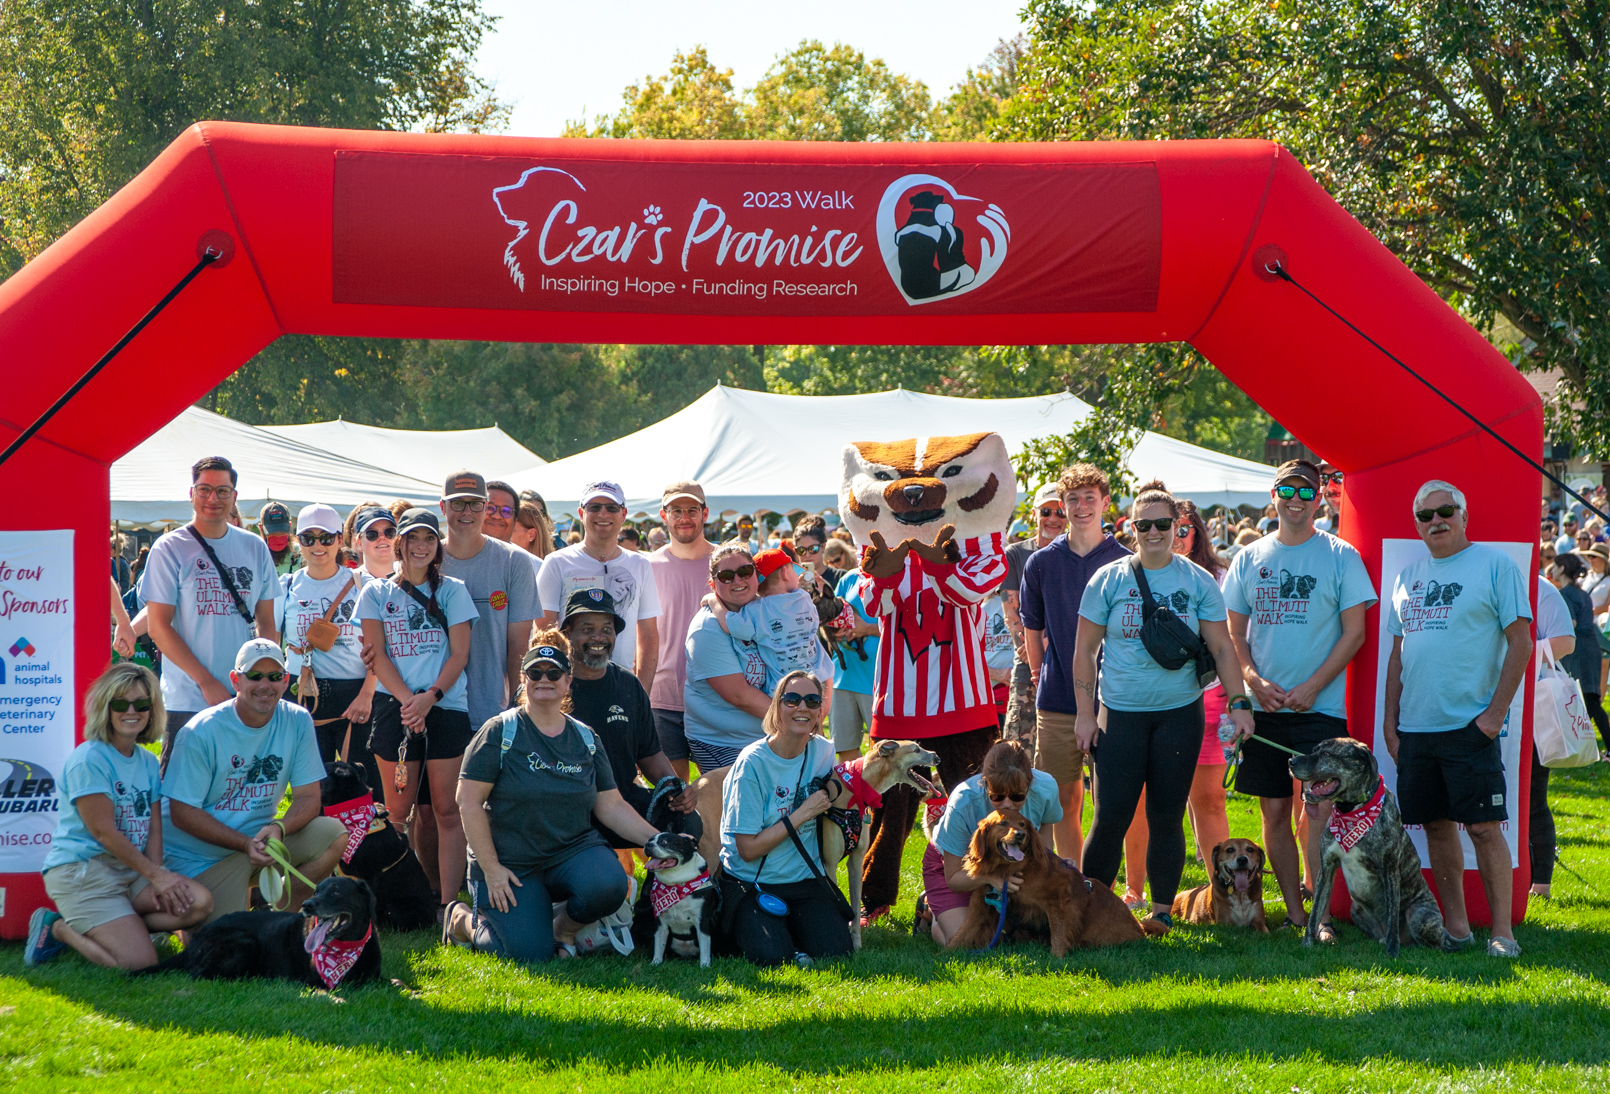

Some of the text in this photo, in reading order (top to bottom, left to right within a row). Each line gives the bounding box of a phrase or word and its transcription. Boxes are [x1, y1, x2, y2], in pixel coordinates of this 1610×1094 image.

[742, 190, 855, 210] 2023 Walk
[681, 197, 864, 272] Promise
[540, 274, 858, 300] Inspiring Hope Funding Research
[16, 565, 45, 582] our
[195, 577, 220, 590] THE
[1255, 587, 1280, 600] THE
[0, 589, 69, 621] Sponsors
[196, 603, 231, 616] WALK
[1402, 596, 1424, 610] THE
[384, 619, 407, 633] THE
[14, 661, 50, 672] animal
[15, 674, 62, 687] hospitals
[606, 715, 629, 723] RAVENS
[2, 724, 46, 734] Center
[0, 778, 55, 799] LER
[1343, 820, 1369, 848] HERO
[656, 890, 680, 912] HERO
